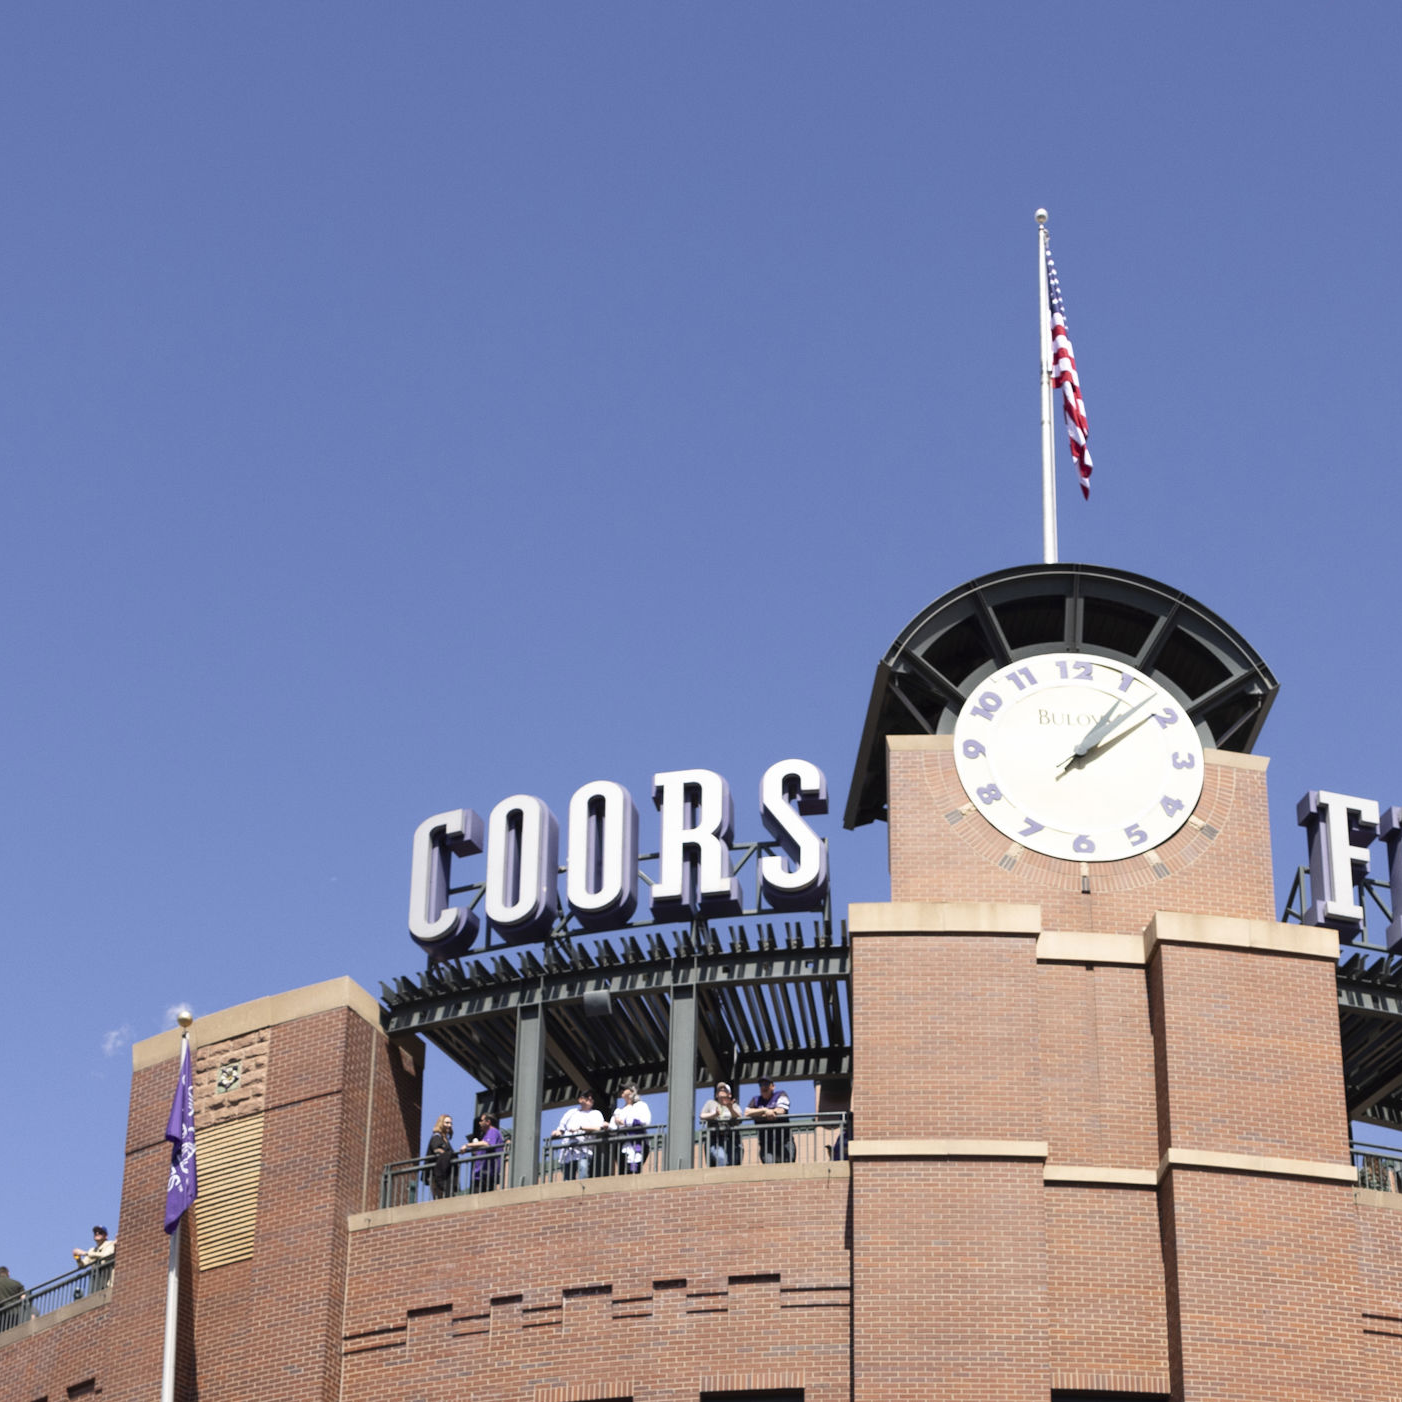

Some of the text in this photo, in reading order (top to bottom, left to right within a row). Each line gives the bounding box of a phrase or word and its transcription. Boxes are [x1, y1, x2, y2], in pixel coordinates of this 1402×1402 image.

[1006, 666, 1038, 691] 11
[1055, 660, 1094, 681] 12
[1117, 671, 1136, 692] 1
[970, 691, 1003, 721] 10
[1038, 708, 1123, 727] BULOV
[1154, 707, 1179, 729] 2
[962, 739, 986, 759] 9
[1171, 751, 1195, 770] 3
[976, 783, 1003, 805] 8
[1160, 795, 1185, 818] 4
[1018, 816, 1045, 837] 7
[1124, 823, 1148, 847] 5
[1072, 834, 1096, 854] 6
[409, 758, 829, 957] COORS
